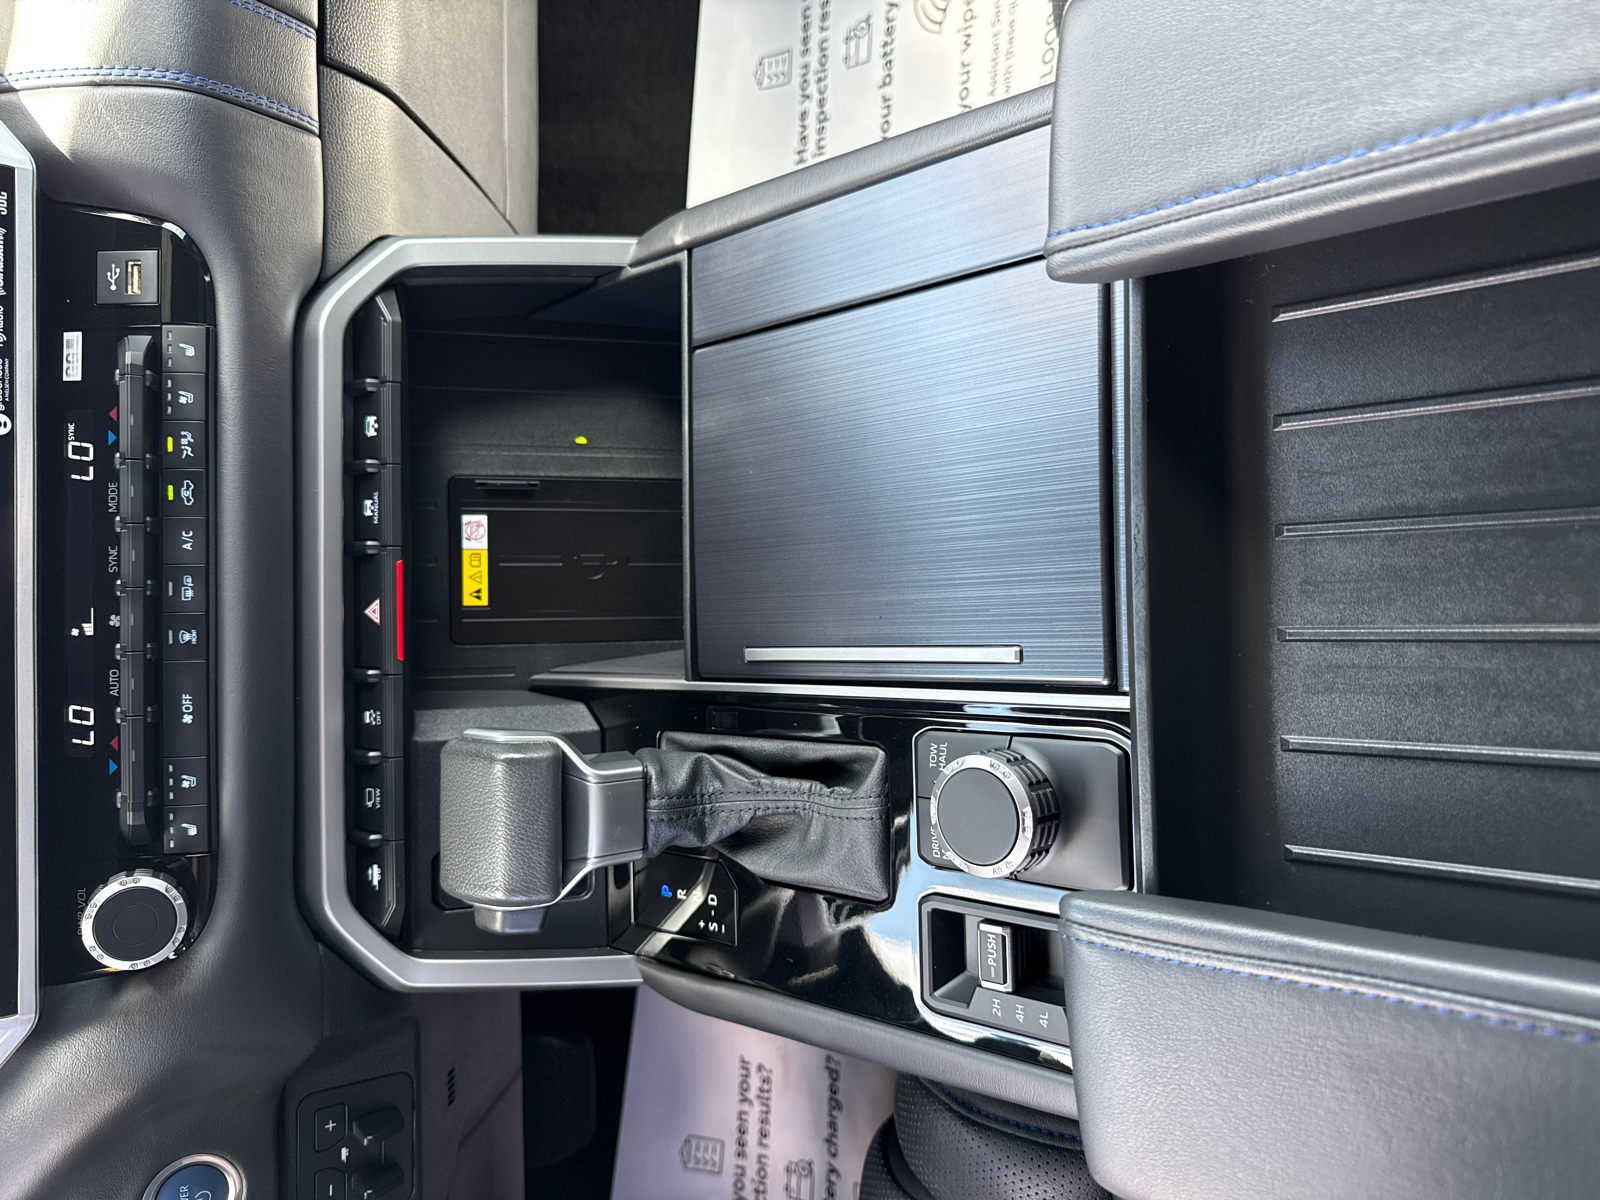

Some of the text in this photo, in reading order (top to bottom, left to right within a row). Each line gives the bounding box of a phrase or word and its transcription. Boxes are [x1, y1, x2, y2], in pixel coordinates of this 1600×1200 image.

[1004, 18, 1016, 61] these
[877, 2, 899, 140] our battery
[987, 31, 1001, 97] Assistant
[793, 6, 814, 166] Have you seen
[957, 60, 973, 113] your
[1003, 64, 1014, 96] with
[811, 38, 831, 158] inspection
[108, 482, 118, 512] MODE
[182, 530, 193, 550] A/C
[108, 545, 118, 573] SYNC
[109, 668, 120, 696] AUTO
[182, 693, 193, 713] OFF
[930, 742, 938, 768] TOW
[939, 742, 948, 770] HAUL
[77, 887, 86, 908] VOL
[661, 885, 672, 897] P
[676, 889, 686, 900] R
[708, 894, 718, 932] S D
[987, 933, 996, 967] PUSH
[993, 998, 1001, 1017] 2H
[1016, 1004, 1024, 1024] 4H
[1040, 1012, 1048, 1028] 4L
[737, 1054, 754, 1108] your
[755, 1063, 773, 1149] results?
[822, 1055, 843, 1158] charged?
[734, 1110, 748, 1160] seen
[180, 1184, 188, 1200] ER
